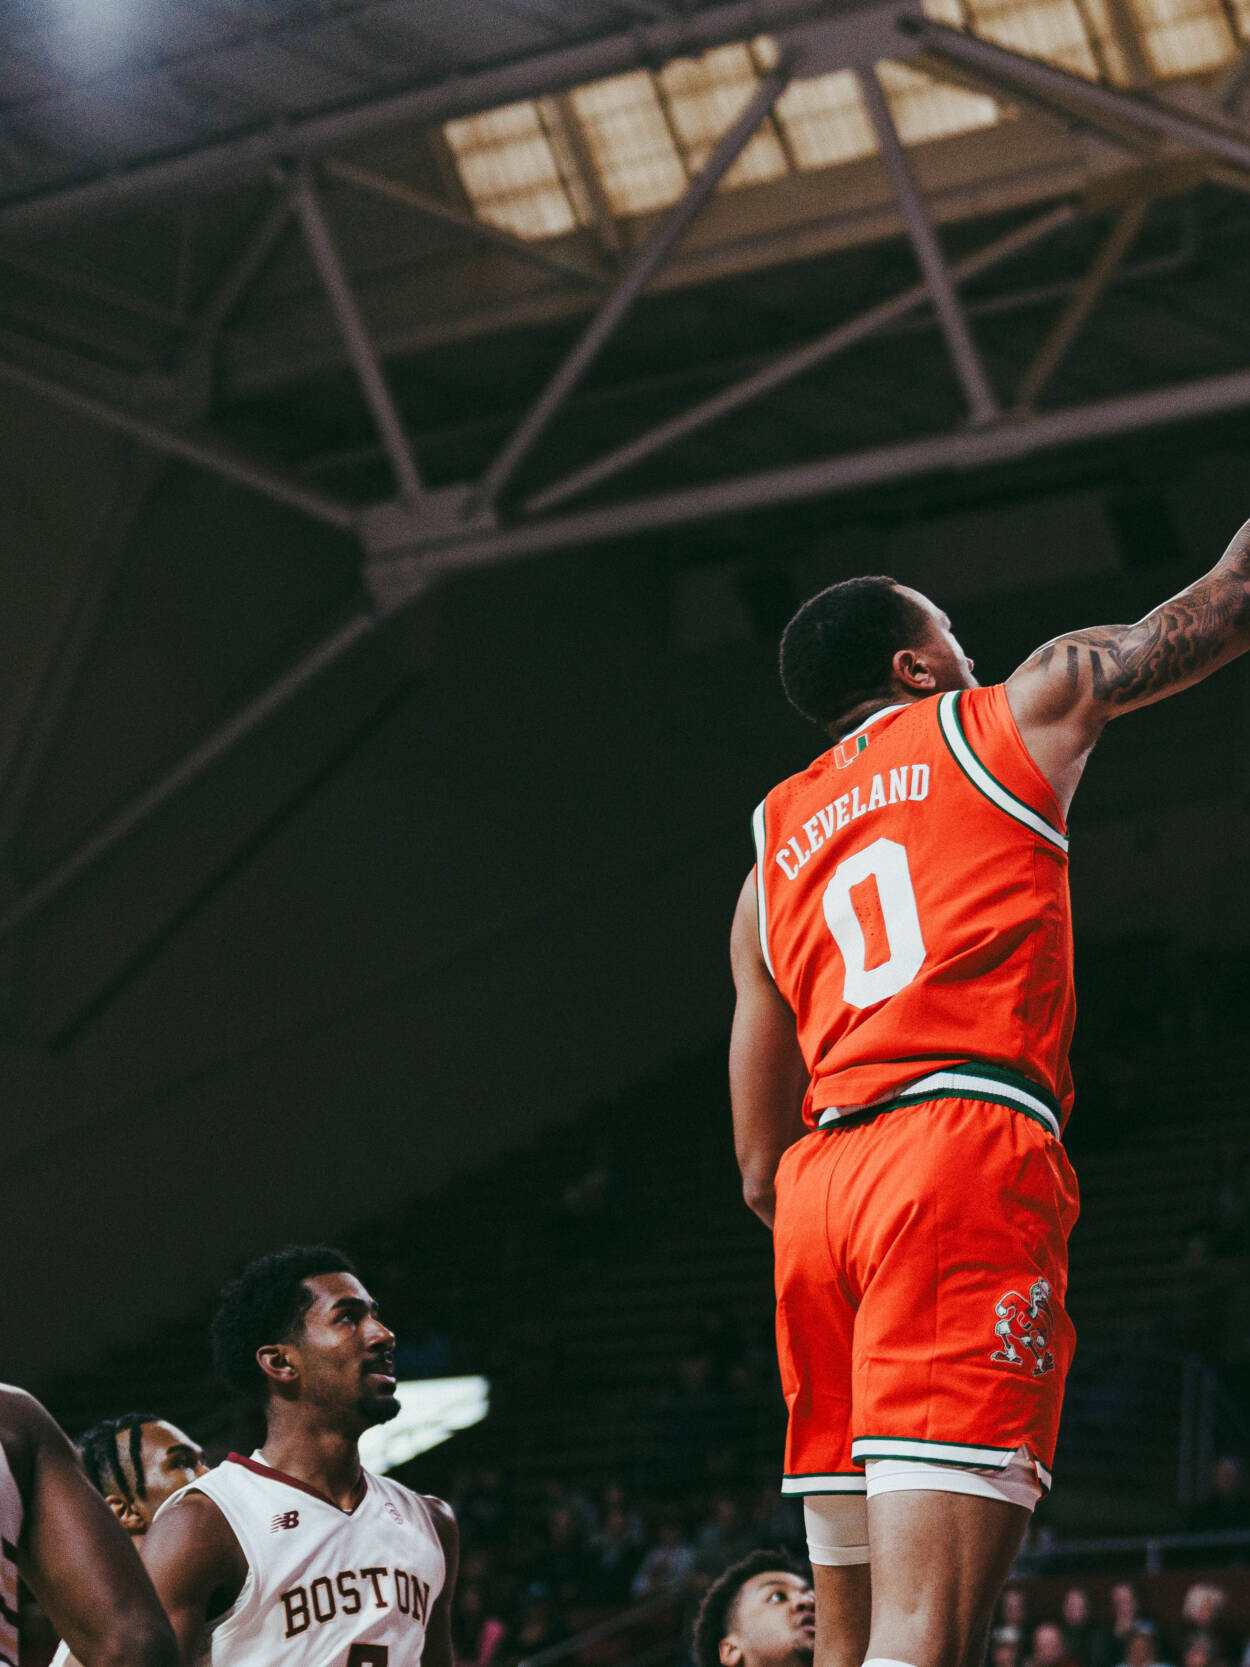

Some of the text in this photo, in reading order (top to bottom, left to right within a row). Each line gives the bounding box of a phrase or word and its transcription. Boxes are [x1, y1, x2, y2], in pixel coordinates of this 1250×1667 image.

[775, 763, 930, 881] CLEVELAND
[822, 837, 927, 1010] 0
[279, 1566, 430, 1640] BOSTON
